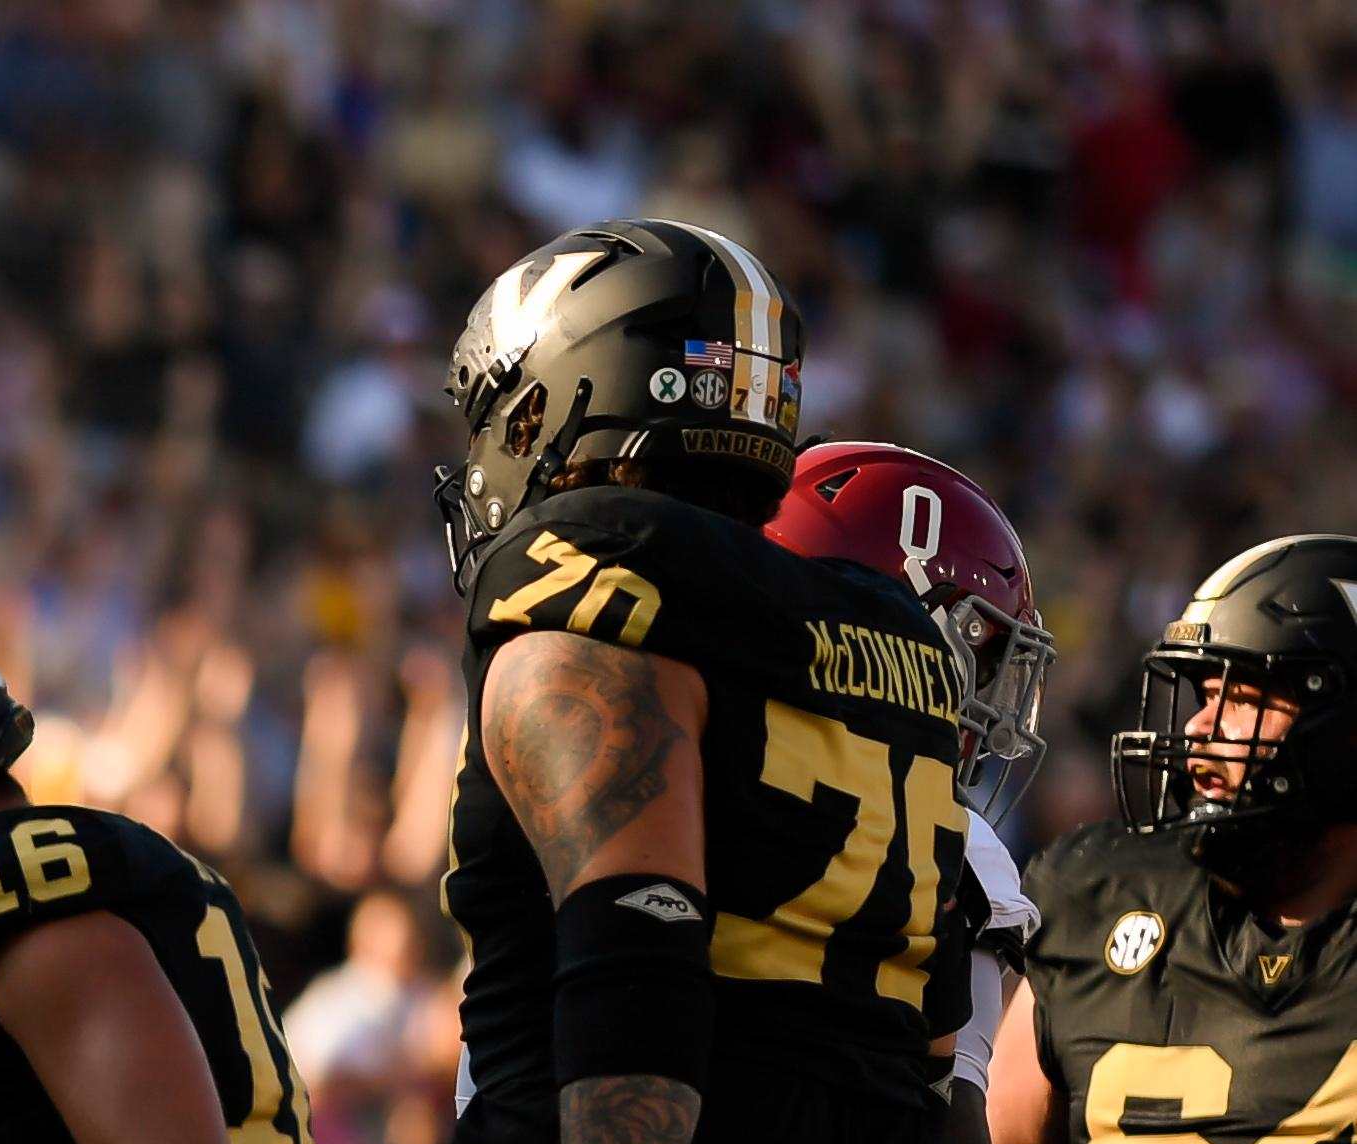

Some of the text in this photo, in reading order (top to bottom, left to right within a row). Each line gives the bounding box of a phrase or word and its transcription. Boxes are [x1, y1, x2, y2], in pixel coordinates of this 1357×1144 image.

[694, 371, 726, 407] SEC
[900, 485, 942, 560] 0
[488, 530, 661, 646] 70
[1107, 912, 1162, 971] SEC
